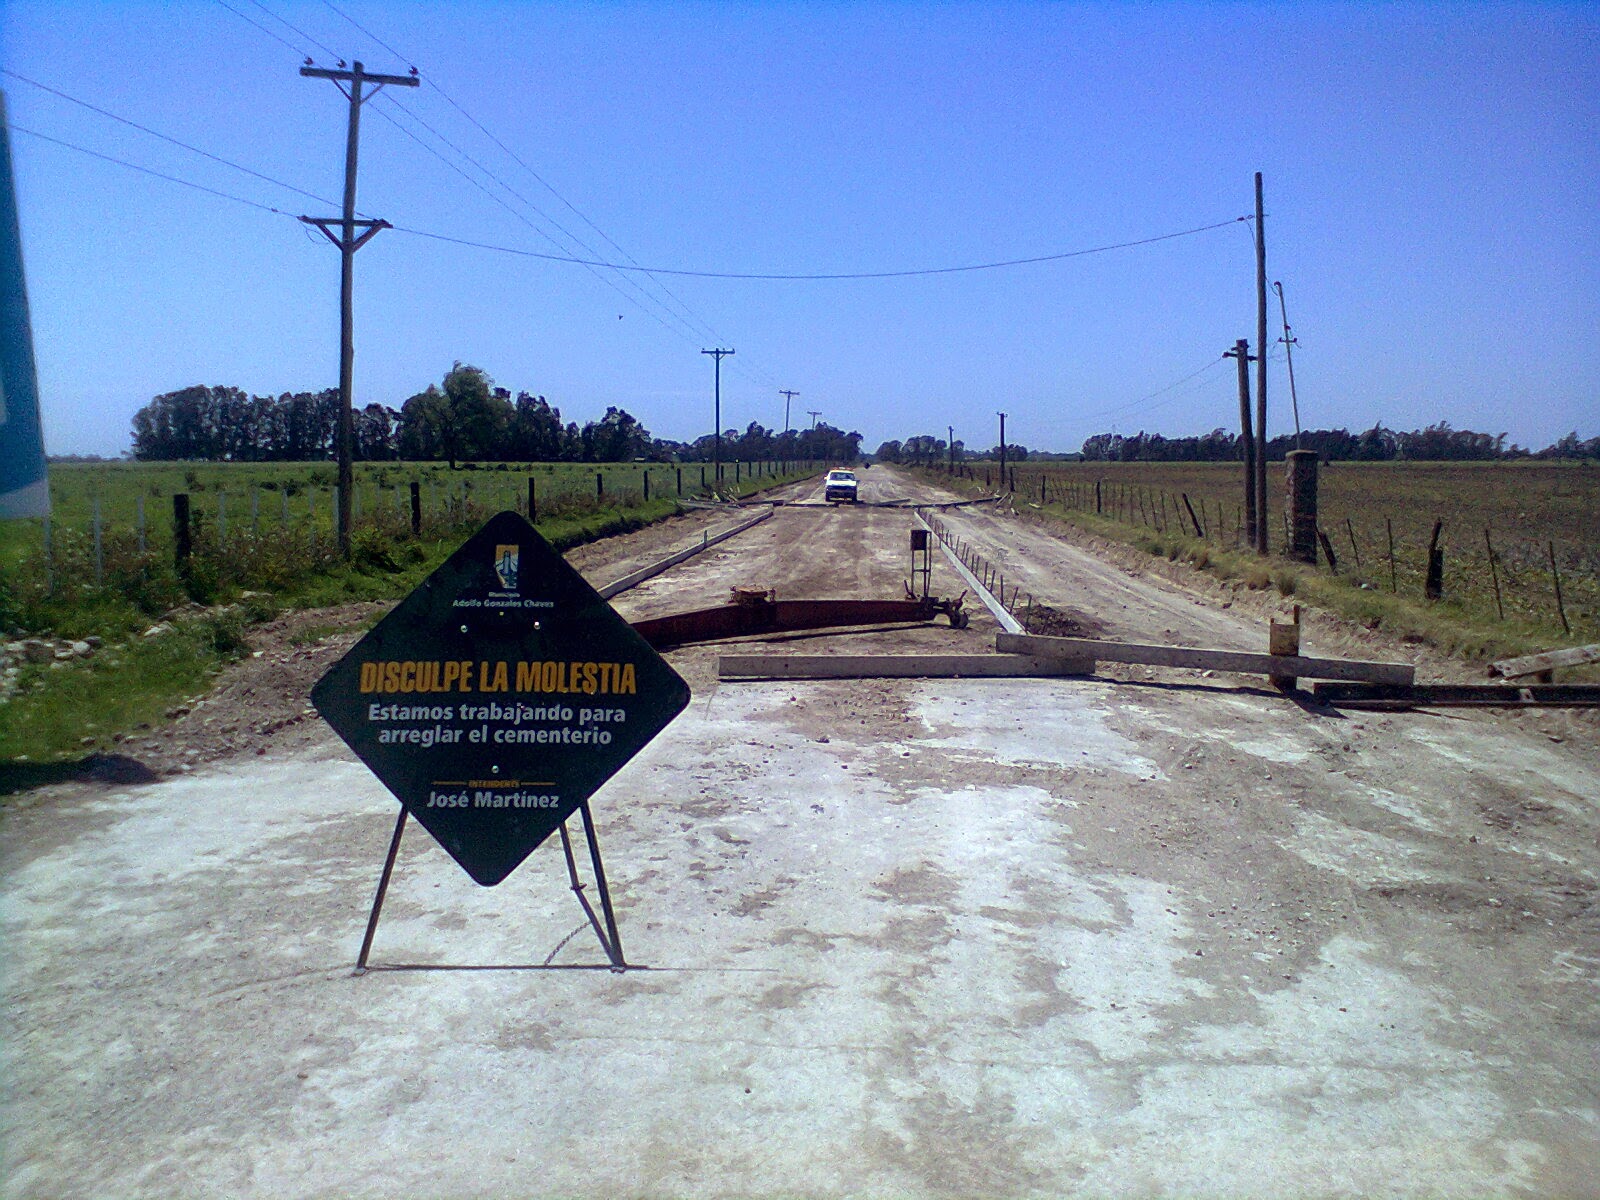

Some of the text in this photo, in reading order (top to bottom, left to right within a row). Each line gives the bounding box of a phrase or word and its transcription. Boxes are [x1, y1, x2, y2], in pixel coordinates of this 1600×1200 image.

[359, 661, 637, 694] DISCULPE LA MOLESTIA
[368, 702, 626, 725] Estamos trabajando para
[378, 724, 612, 748] arreglar el cementerio
[426, 790, 559, 808] José Martínez
